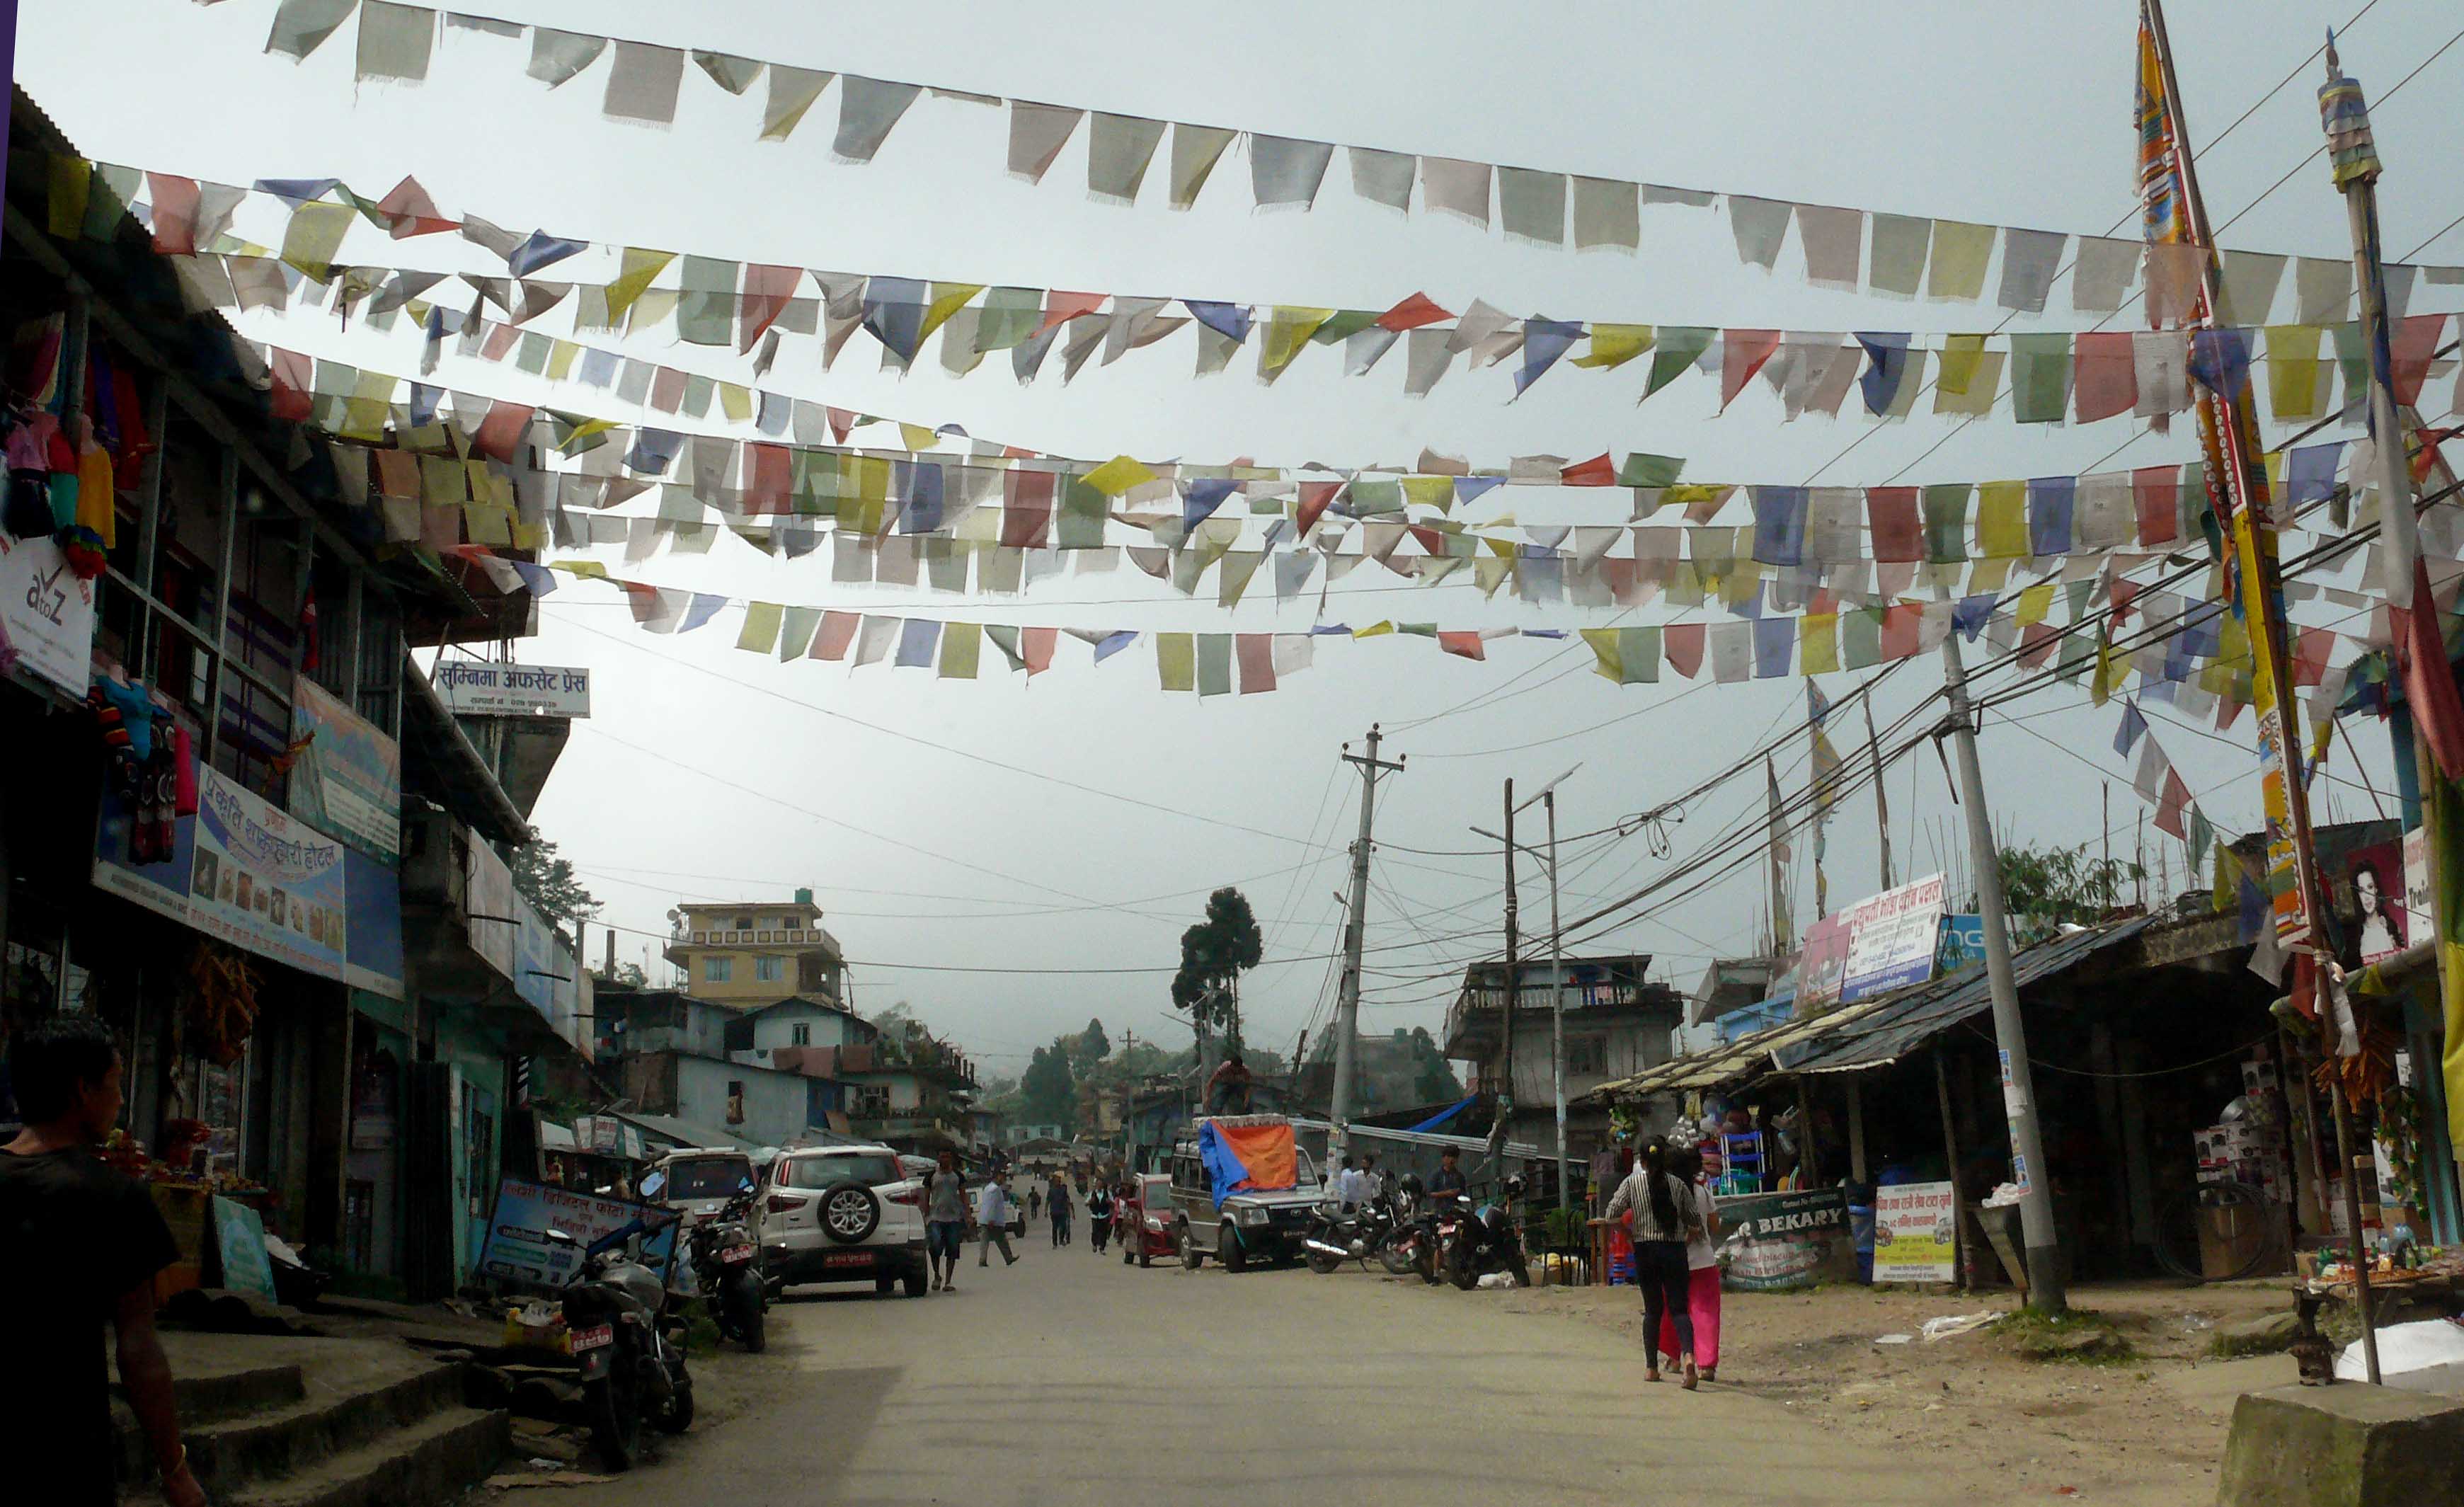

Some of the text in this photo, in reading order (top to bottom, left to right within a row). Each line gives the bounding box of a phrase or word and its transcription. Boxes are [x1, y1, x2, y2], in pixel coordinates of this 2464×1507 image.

[503, 668, 558, 691] अफसेट
[563, 669, 586, 693] प्रेस
[304, 841, 336, 870] होटल
[1757, 1208, 1843, 1234] BEKARY
